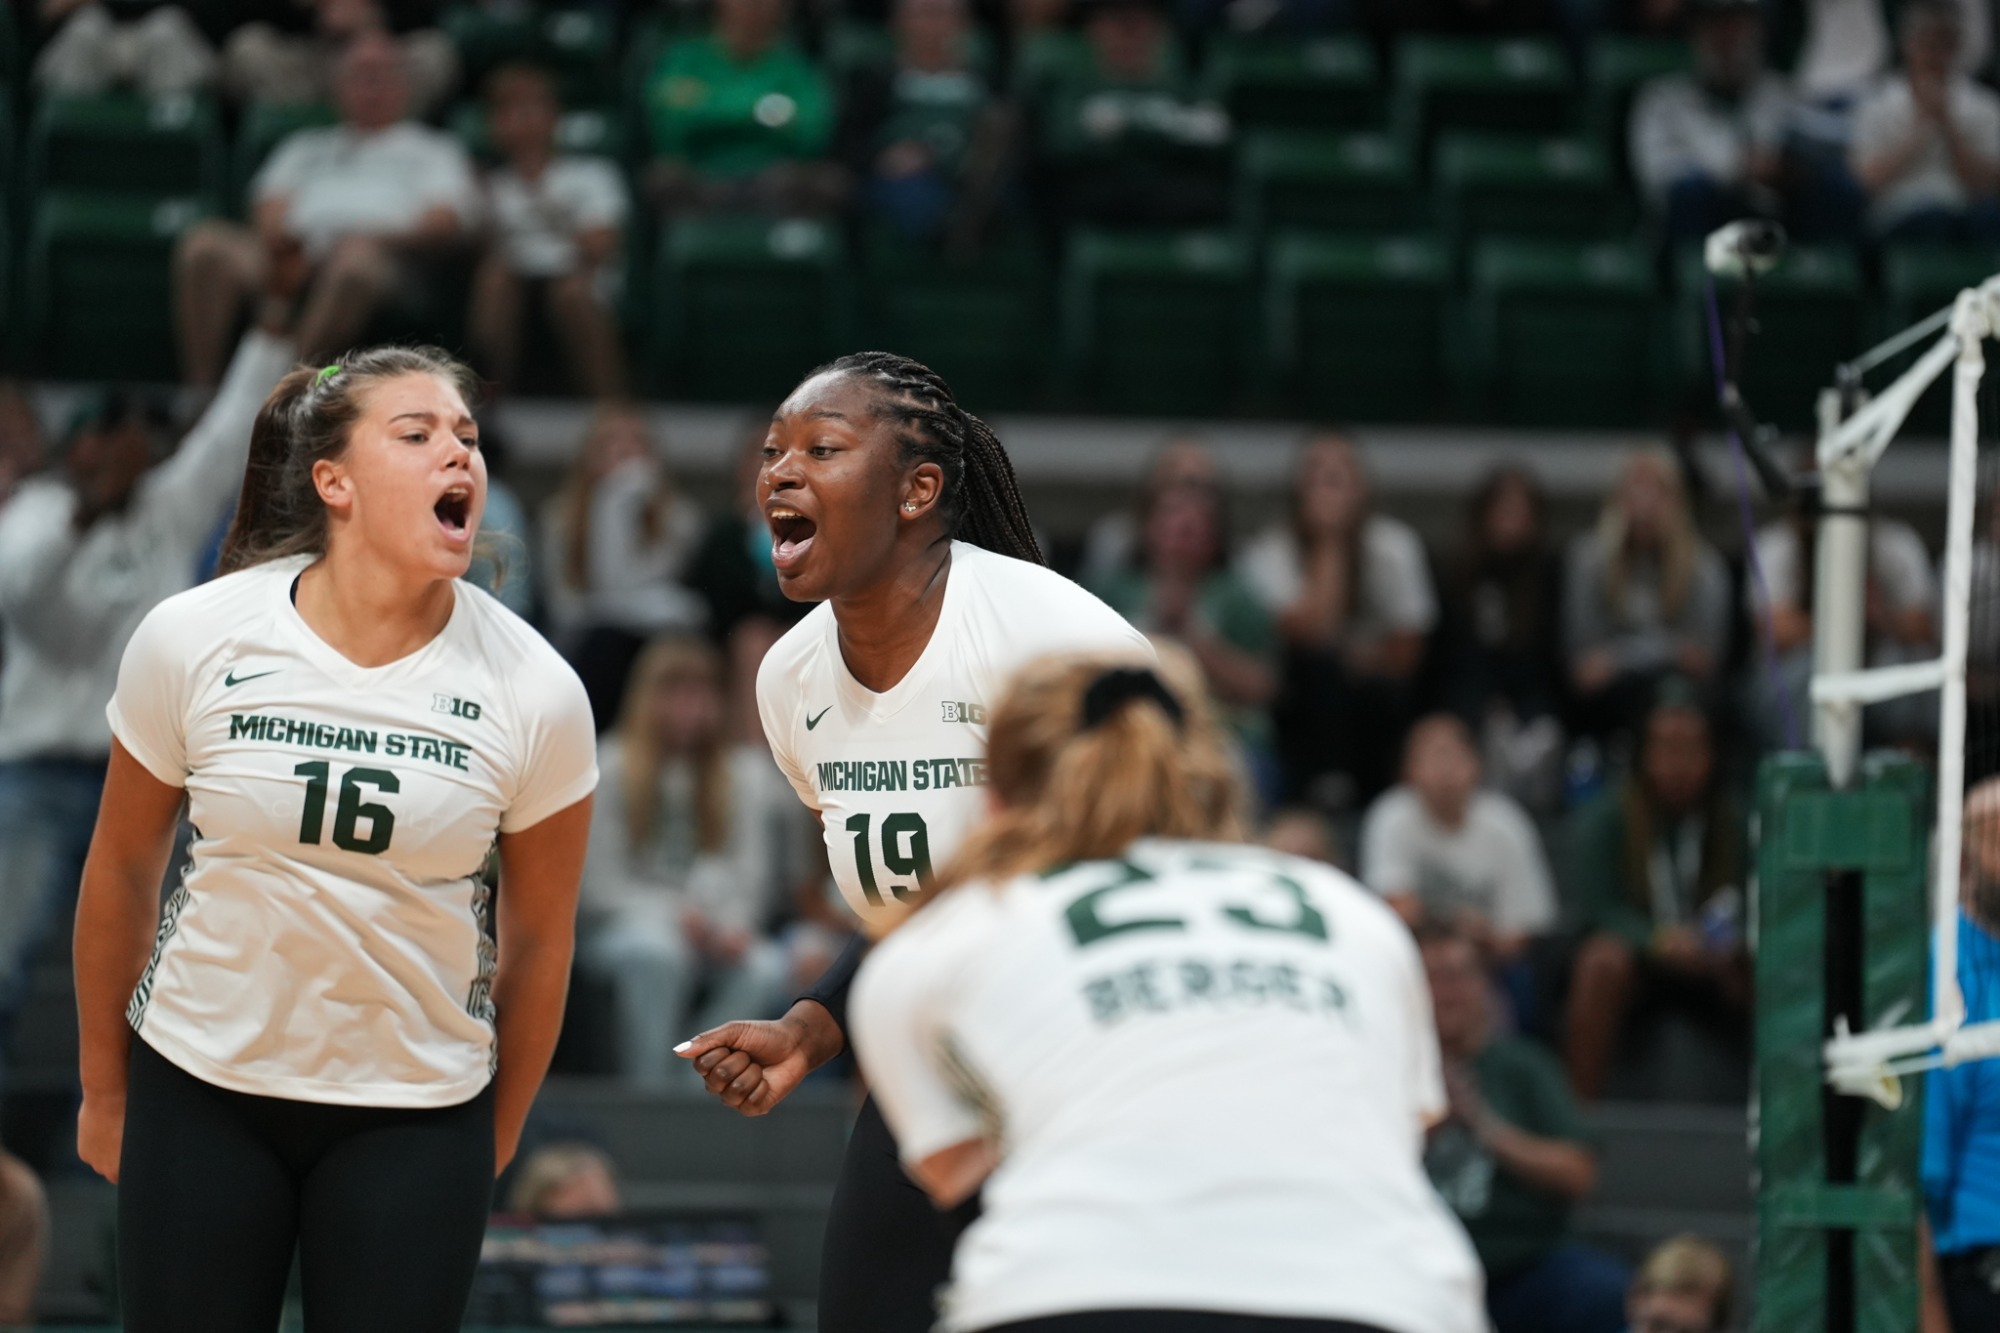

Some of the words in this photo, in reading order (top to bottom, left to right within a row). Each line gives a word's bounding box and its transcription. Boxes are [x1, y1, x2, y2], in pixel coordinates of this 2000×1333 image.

[228, 714, 377, 754] MICHIGAN
[384, 734, 473, 772] STATE
[817, 760, 908, 791] MICHIGAN
[912, 757, 989, 790] STATE
[294, 760, 400, 855] 16
[845, 812, 938, 907] 19
